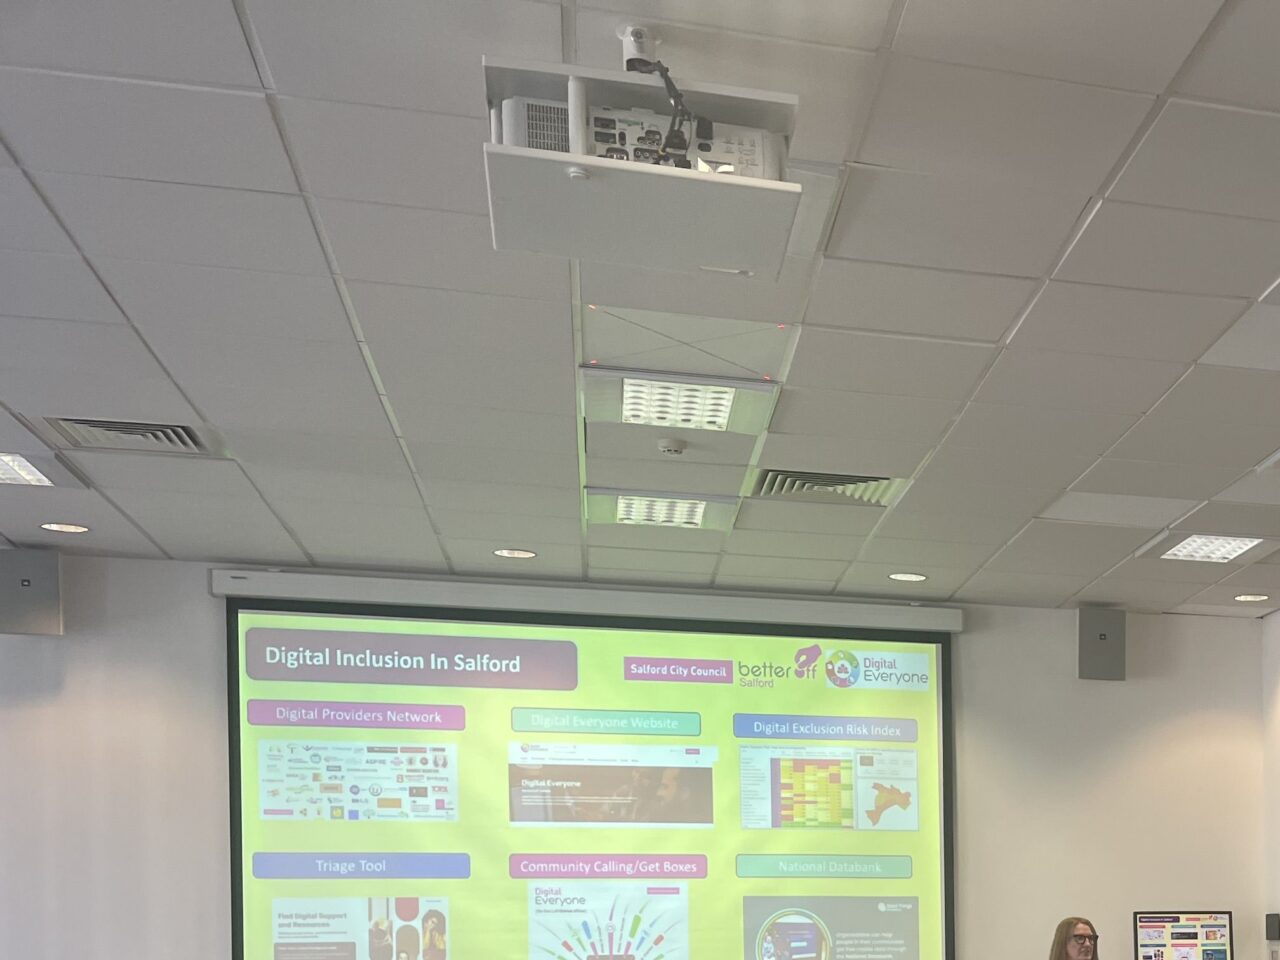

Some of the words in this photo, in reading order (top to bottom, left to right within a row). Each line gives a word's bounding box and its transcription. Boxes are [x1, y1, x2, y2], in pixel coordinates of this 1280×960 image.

[265, 646, 330, 667] Digital
[336, 651, 424, 669] Inclusion
[430, 653, 448, 671] In
[454, 654, 521, 673] Salford
[863, 656, 896, 670] Digital
[630, 664, 668, 676] Salford
[670, 665, 688, 678] City
[690, 665, 727, 678] Council
[738, 661, 791, 679] better
[863, 669, 928, 685] Everyone
[739, 678, 774, 689] Salford
[276, 707, 318, 722] Digital
[322, 708, 383, 723] Providers
[387, 710, 442, 724] Network
[531, 714, 570, 728] Digital
[573, 715, 628, 729] Everyone
[631, 717, 679, 730] Website
[754, 721, 790, 734] Digital
[792, 723, 844, 736] Exclusion
[846, 724, 868, 736] Risk
[871, 725, 901, 737] Index
[521, 778, 546, 788] Digital
[547, 780, 581, 789] Everyone
[316, 859, 356, 874] Triage
[361, 860, 386, 872] Tool
[520, 860, 592, 875] Community
[594, 860, 660, 876] Calling/Get
[664, 861, 697, 874] Boxes
[778, 861, 826, 872] National
[829, 862, 882, 873] Databank
[534, 887, 562, 897] Digital
[534, 896, 586, 906] Everyone
[278, 912, 294, 920] Find
[295, 912, 318, 921] Digital
[318, 912, 347, 921] Support
